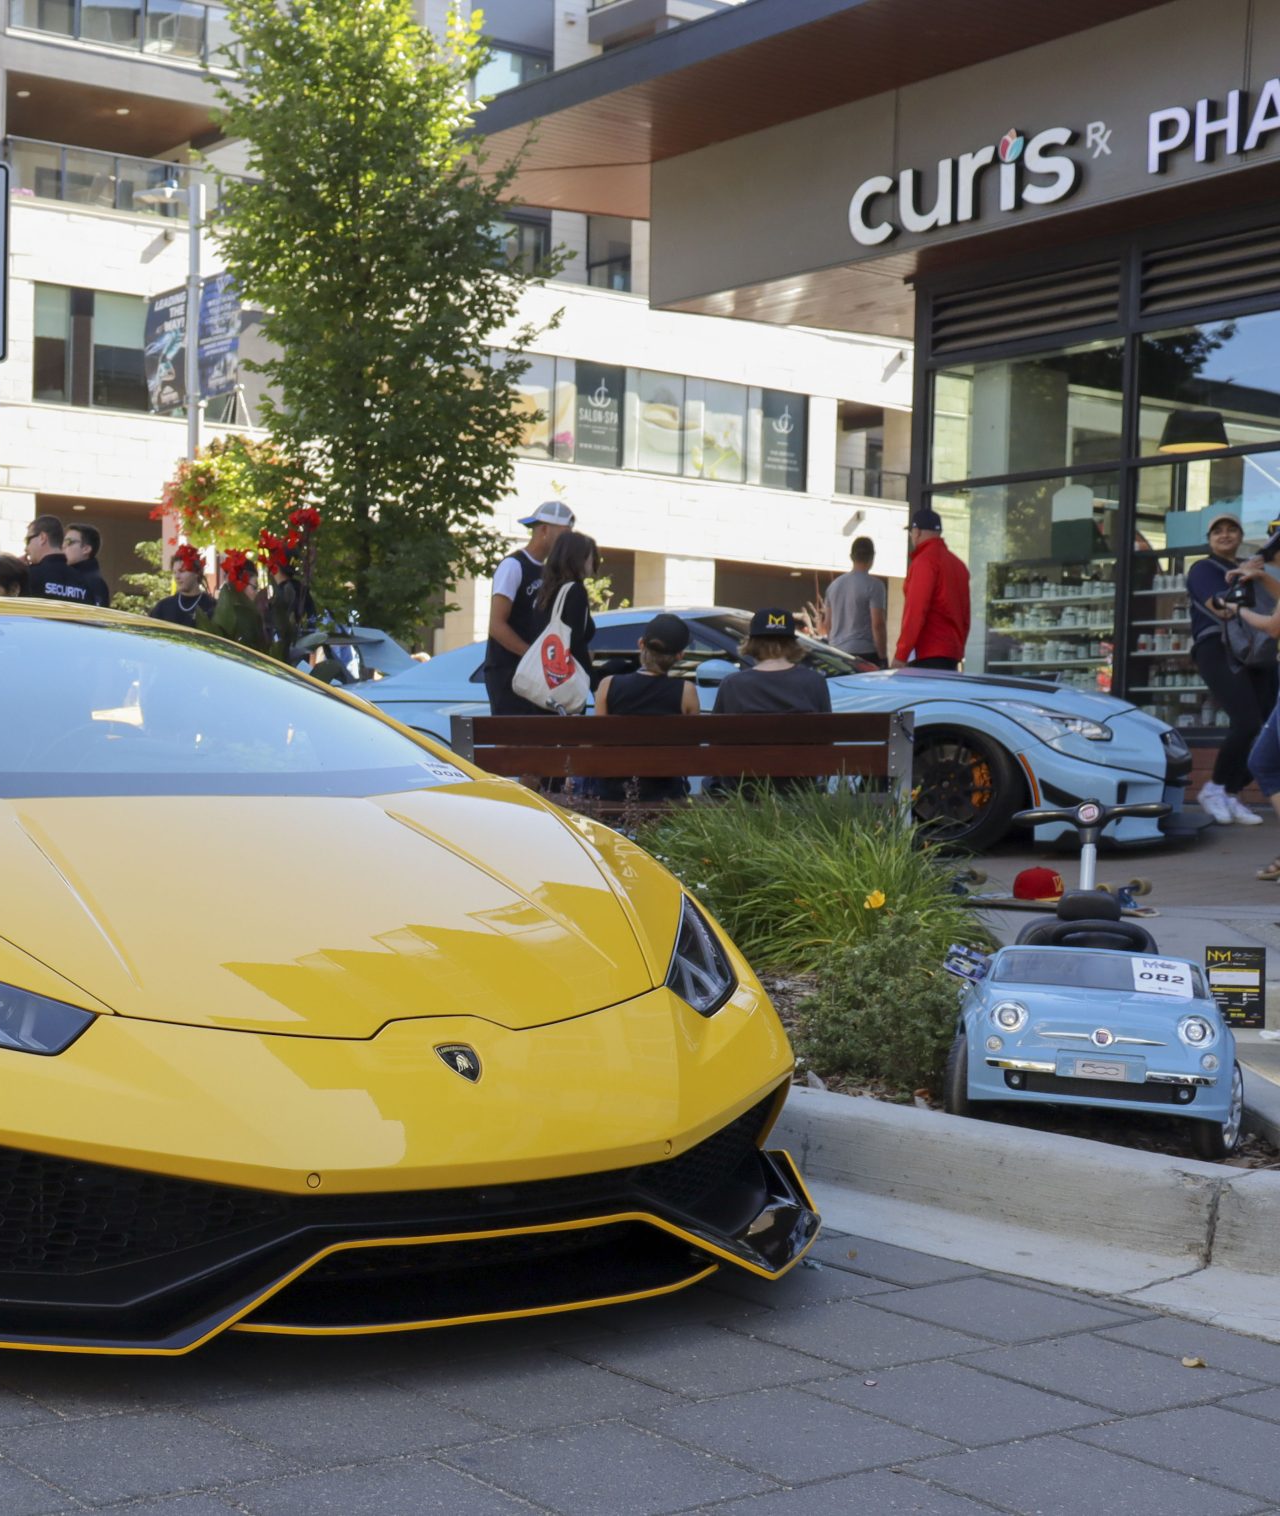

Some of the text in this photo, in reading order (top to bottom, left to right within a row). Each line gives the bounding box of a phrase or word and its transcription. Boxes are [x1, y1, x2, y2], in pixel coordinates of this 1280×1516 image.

[848, 127, 1076, 246] curis
[169, 304, 185, 318] THE
[45, 582, 87, 600] SECURITY
[1139, 972, 1185, 985] 082
